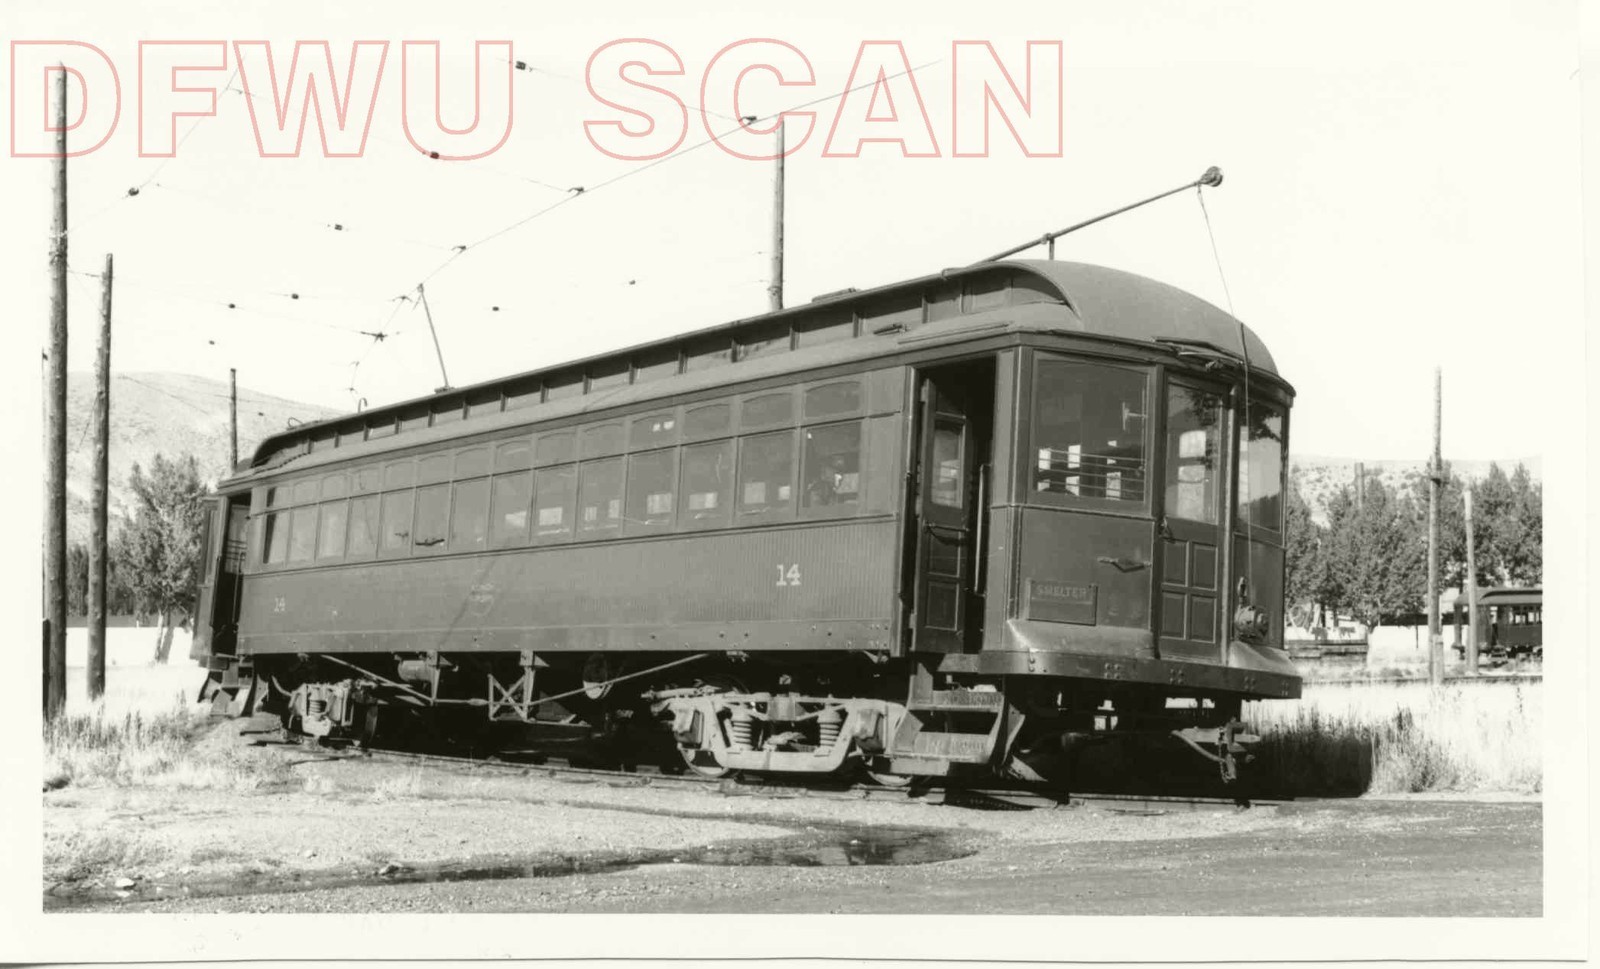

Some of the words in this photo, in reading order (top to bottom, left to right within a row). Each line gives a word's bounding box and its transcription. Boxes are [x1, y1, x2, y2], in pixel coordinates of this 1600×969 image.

[776, 563, 802, 587] 14
[1035, 584, 1087, 599] SMELTER
[274, 597, 286, 613] 14
